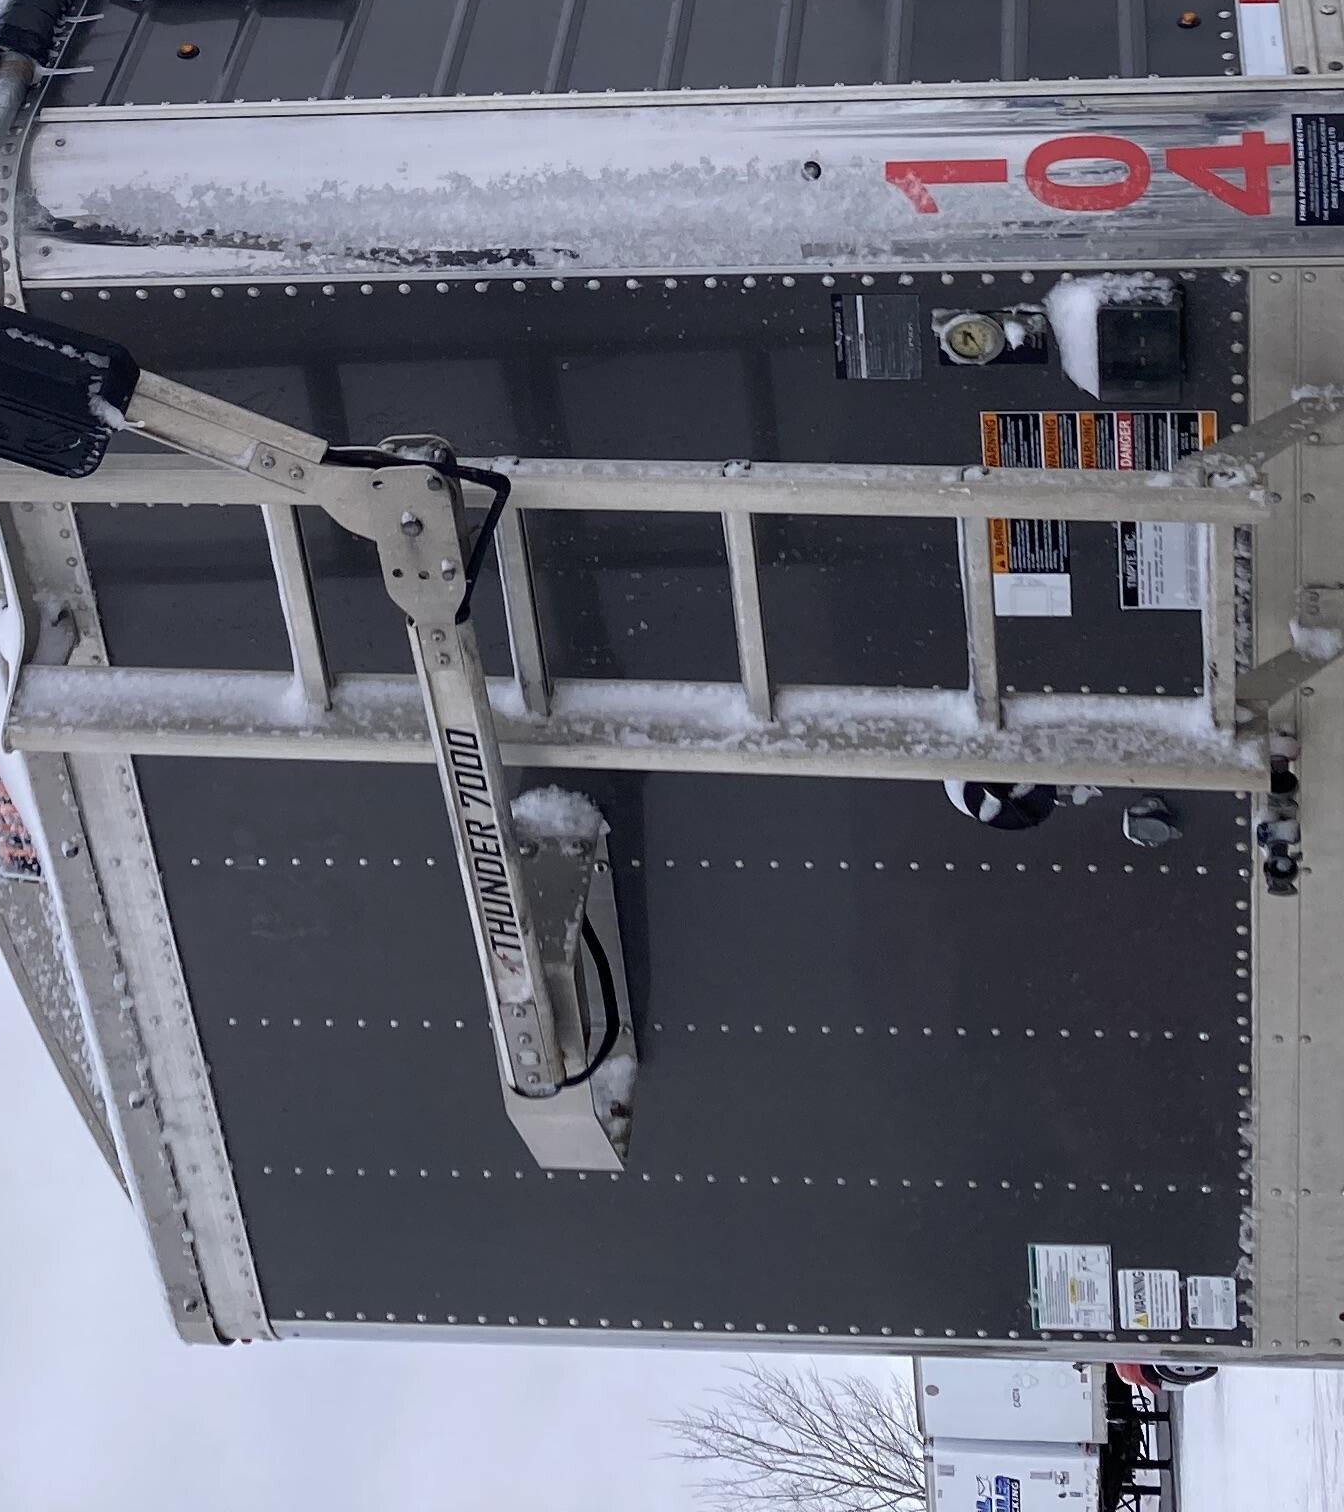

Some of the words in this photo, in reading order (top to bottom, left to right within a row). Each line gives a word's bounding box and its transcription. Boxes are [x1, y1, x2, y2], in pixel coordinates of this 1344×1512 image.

[1296, 117, 1305, 159] INSPECTION
[884, 128, 1292, 215] 104
[1331, 182, 1339, 209] DIRECT
[1118, 419, 1133, 467] DANGER
[444, 728, 491, 809] 7000
[464, 820, 522, 952] THUNDER
[1132, 1272, 1147, 1314] WARNING
